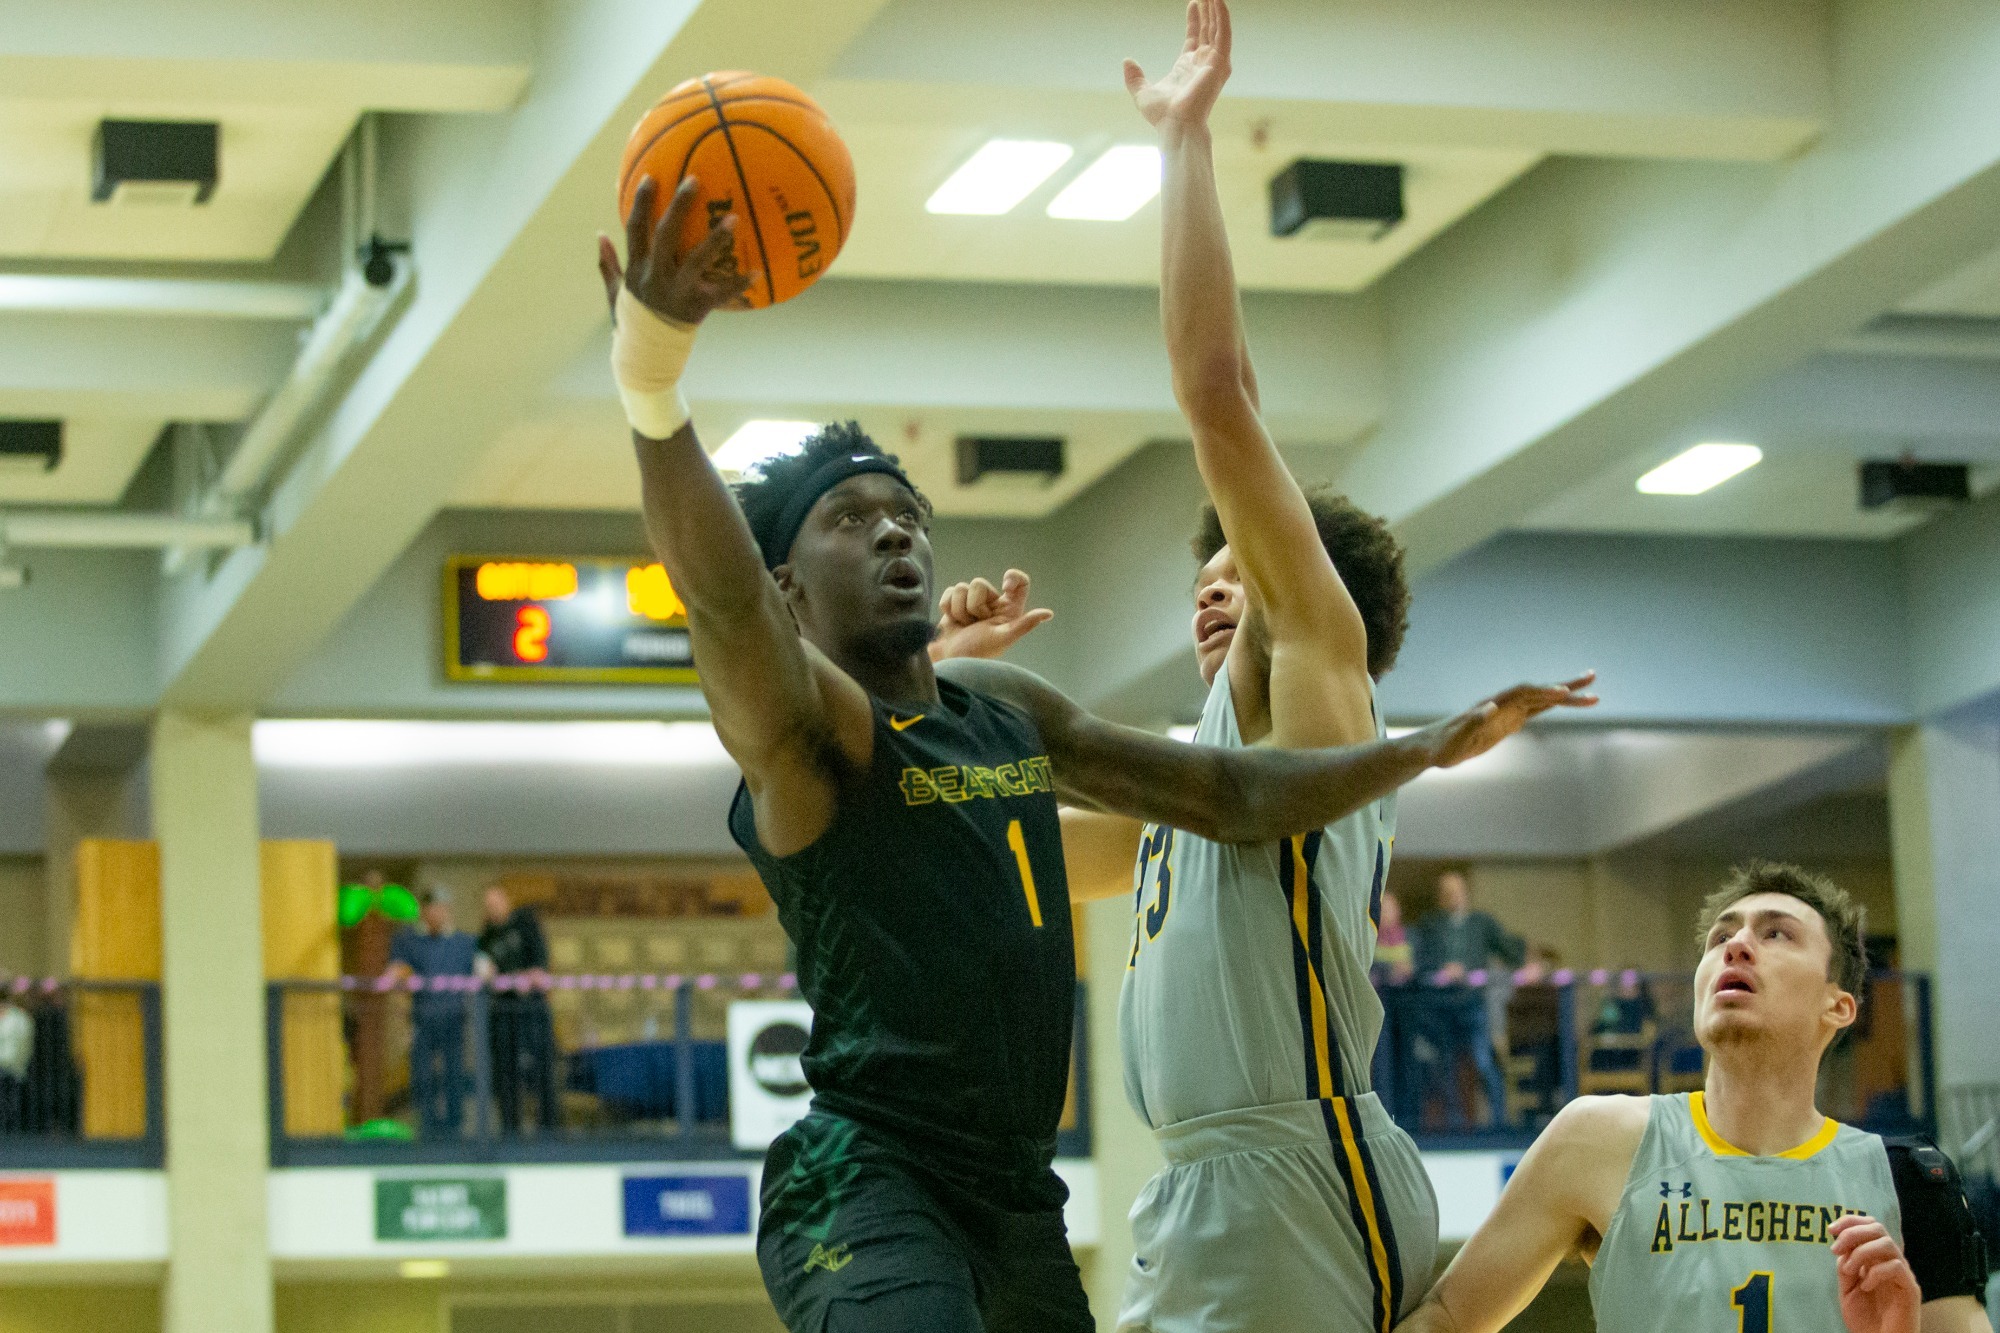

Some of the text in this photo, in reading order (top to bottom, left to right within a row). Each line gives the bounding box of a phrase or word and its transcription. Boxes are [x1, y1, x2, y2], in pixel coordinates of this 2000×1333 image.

[513, 604, 551, 663] 2
[899, 755, 1054, 806] BEARCAT
[1007, 819, 1043, 927] 1
[1650, 1198, 1868, 1253] ALLEGHEN
[1731, 1271, 1774, 1333] 1
